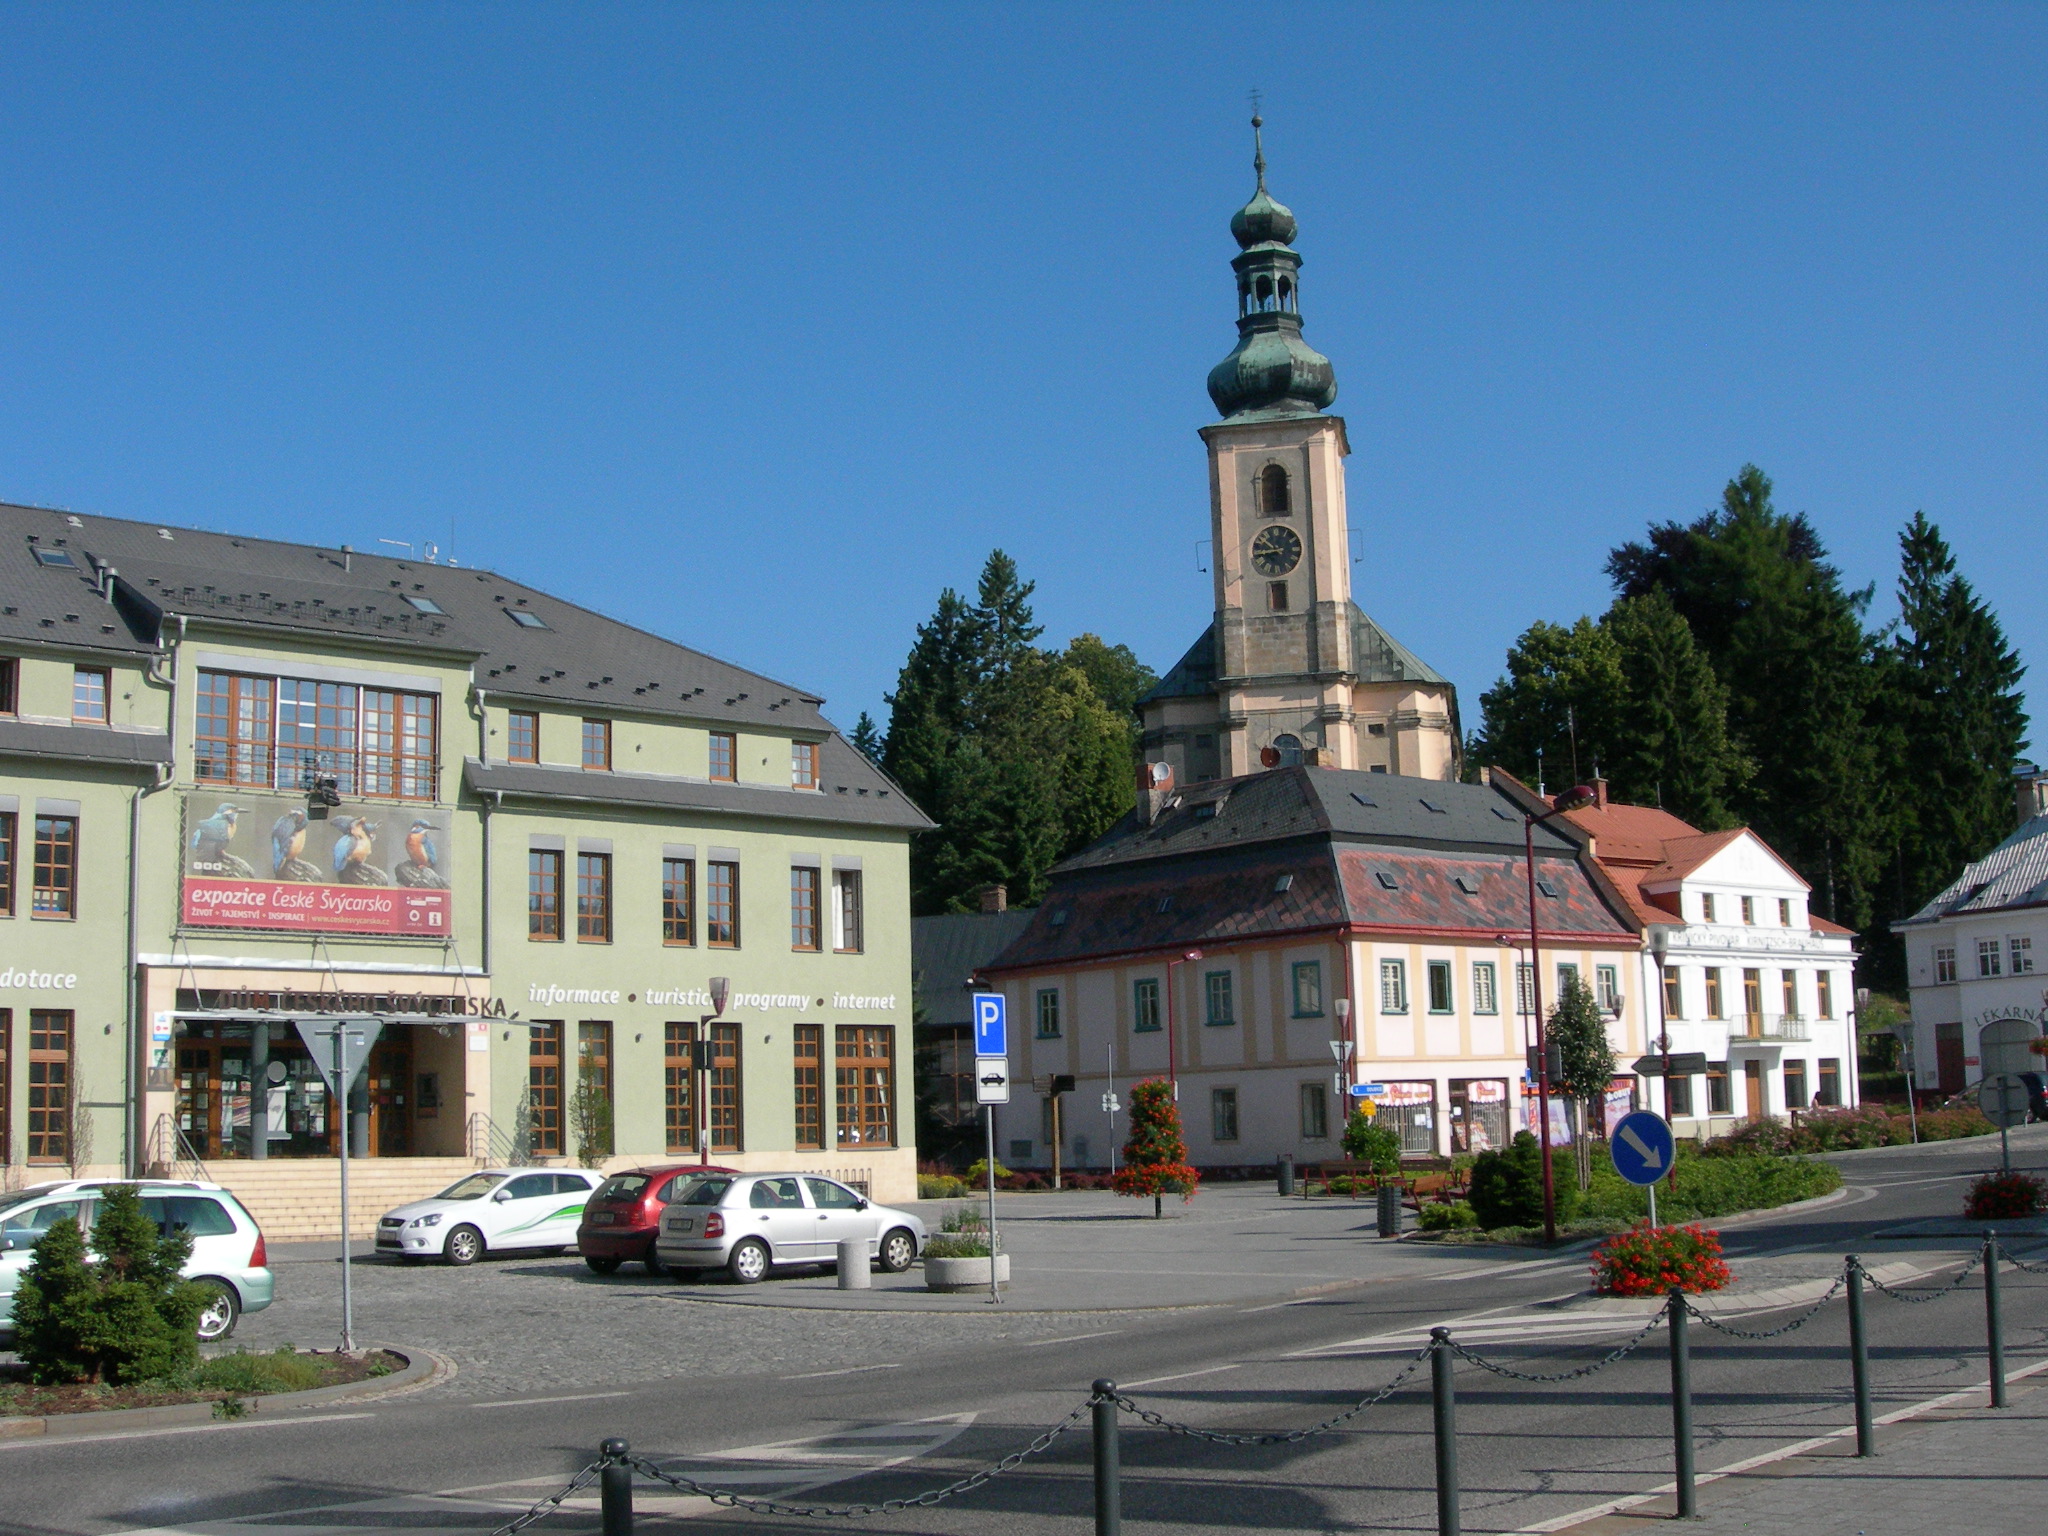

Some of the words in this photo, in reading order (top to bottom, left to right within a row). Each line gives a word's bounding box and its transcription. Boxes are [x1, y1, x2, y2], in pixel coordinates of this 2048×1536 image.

[191, 886, 267, 908] expozice
[272, 886, 315, 908] České
[320, 889, 392, 914] Švýcarsko
[191, 906, 213, 917] ŽIVOT
[221, 909, 260, 920] TAJEMSTVÍ
[268, 911, 305, 922] INSPIRACE
[0, 966, 78, 989] dotace
[219, 984, 270, 1010] DŮM
[281, 986, 377, 1013] ČESKÉHO
[385, 990, 507, 1016] ŠVÝCARSKA
[528, 983, 620, 1008] informace
[646, 987, 714, 1006] turistic
[732, 992, 811, 1012] programy
[832, 991, 896, 1010] internet
[981, 1001, 999, 1036] P
[1974, 1005, 2044, 1027] LÉKÁRNA
